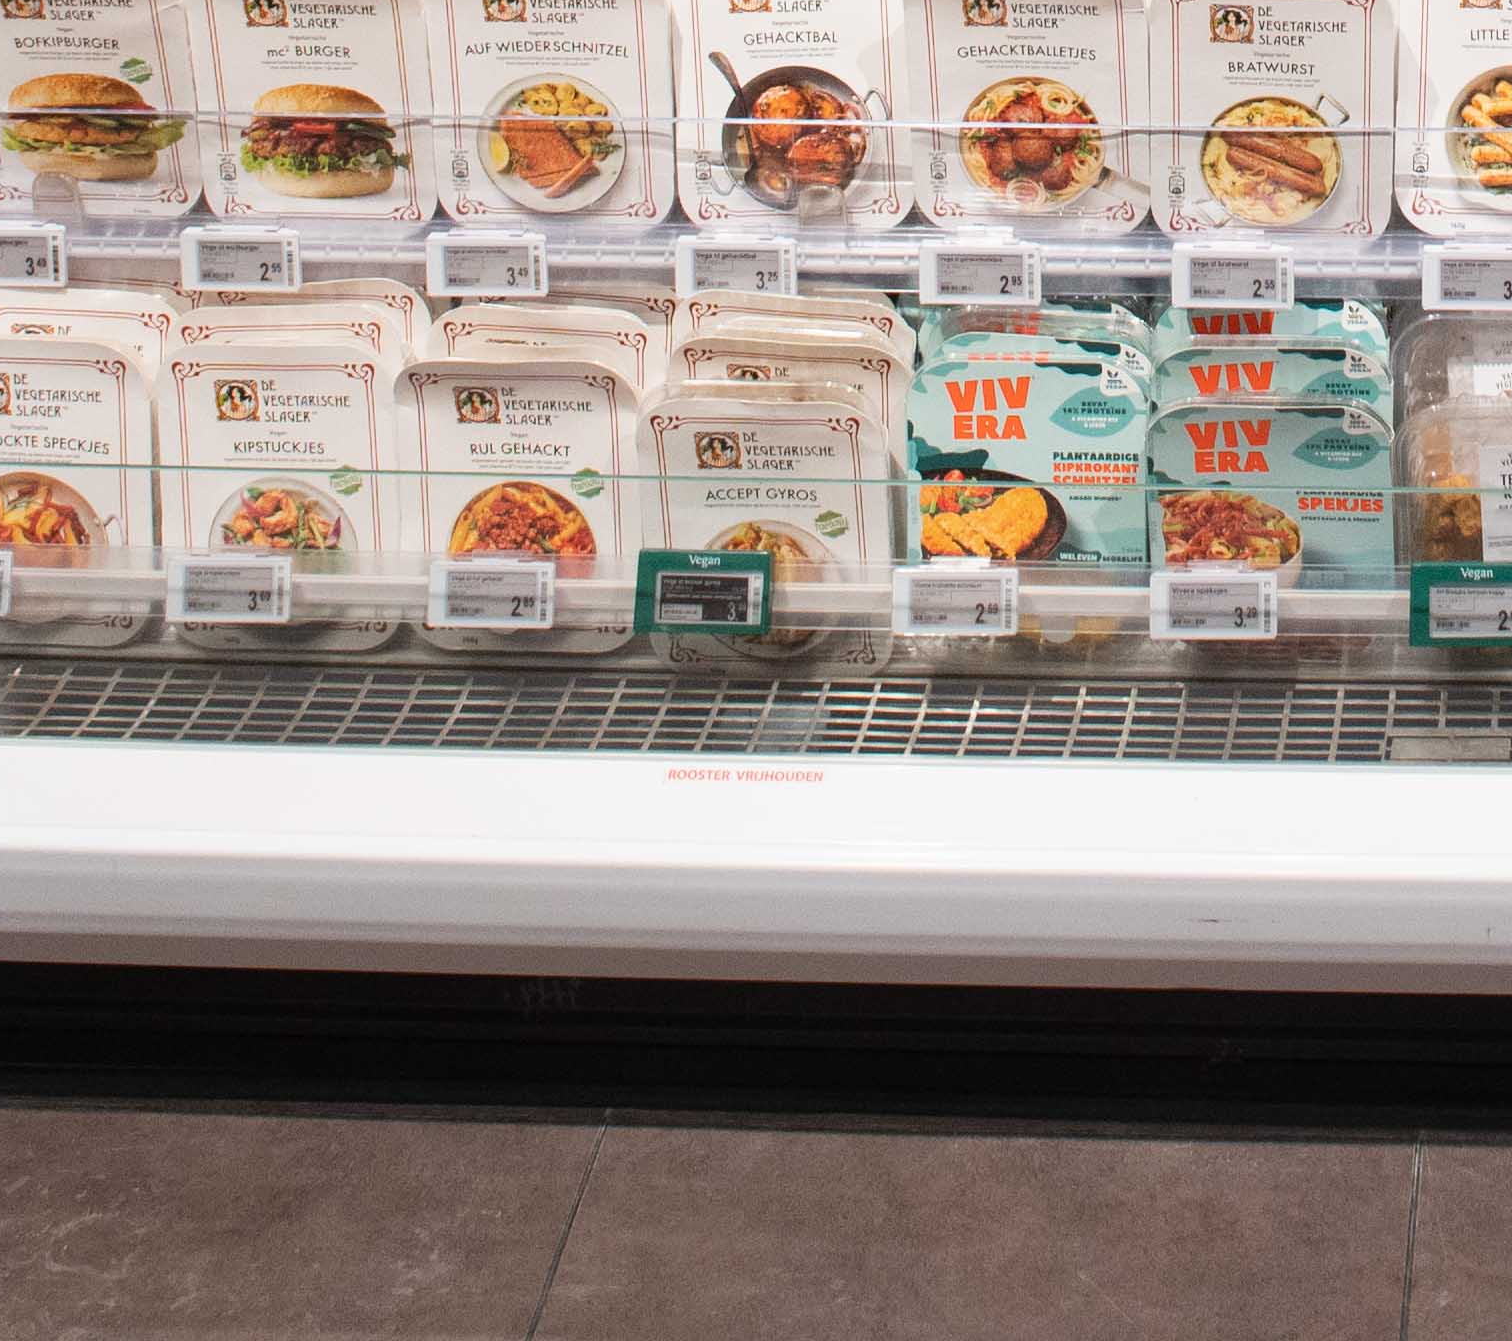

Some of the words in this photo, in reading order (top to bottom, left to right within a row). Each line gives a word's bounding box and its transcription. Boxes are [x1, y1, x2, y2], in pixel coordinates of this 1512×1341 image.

[50, 10, 94, 20] SLAGER
[15, 37, 120, 49] BOFKIPBURGER
[744, 31, 838, 47] GEHACKTBAL
[1470, 29, 1511, 44] LITTLE
[465, 42, 491, 57] AUF
[496, 40, 630, 59] WIEDERSCHNITZEL
[957, 45, 1096, 61] GEHACKTBALLETJES
[1228, 61, 1315, 76] BRATWURST
[945, 376, 1031, 412] VIV
[953, 414, 1027, 440] ERA
[44, 437, 109, 455] SPECKJES
[234, 440, 325, 455] KIPSTUCKJES
[470, 442, 496, 457] RUL
[501, 442, 570, 458] GEHACKT
[1052, 451, 1139, 463] PLANTAARDIGE
[1053, 462, 1139, 474] KIPKROKANT
[706, 487, 761, 503] ACCEPT
[766, 487, 817, 502] GYROS
[1298, 496, 1383, 514] SPEKJES
[668, 769, 730, 781] ROOSTER
[736, 770, 824, 782] VRIJHOUDEN
